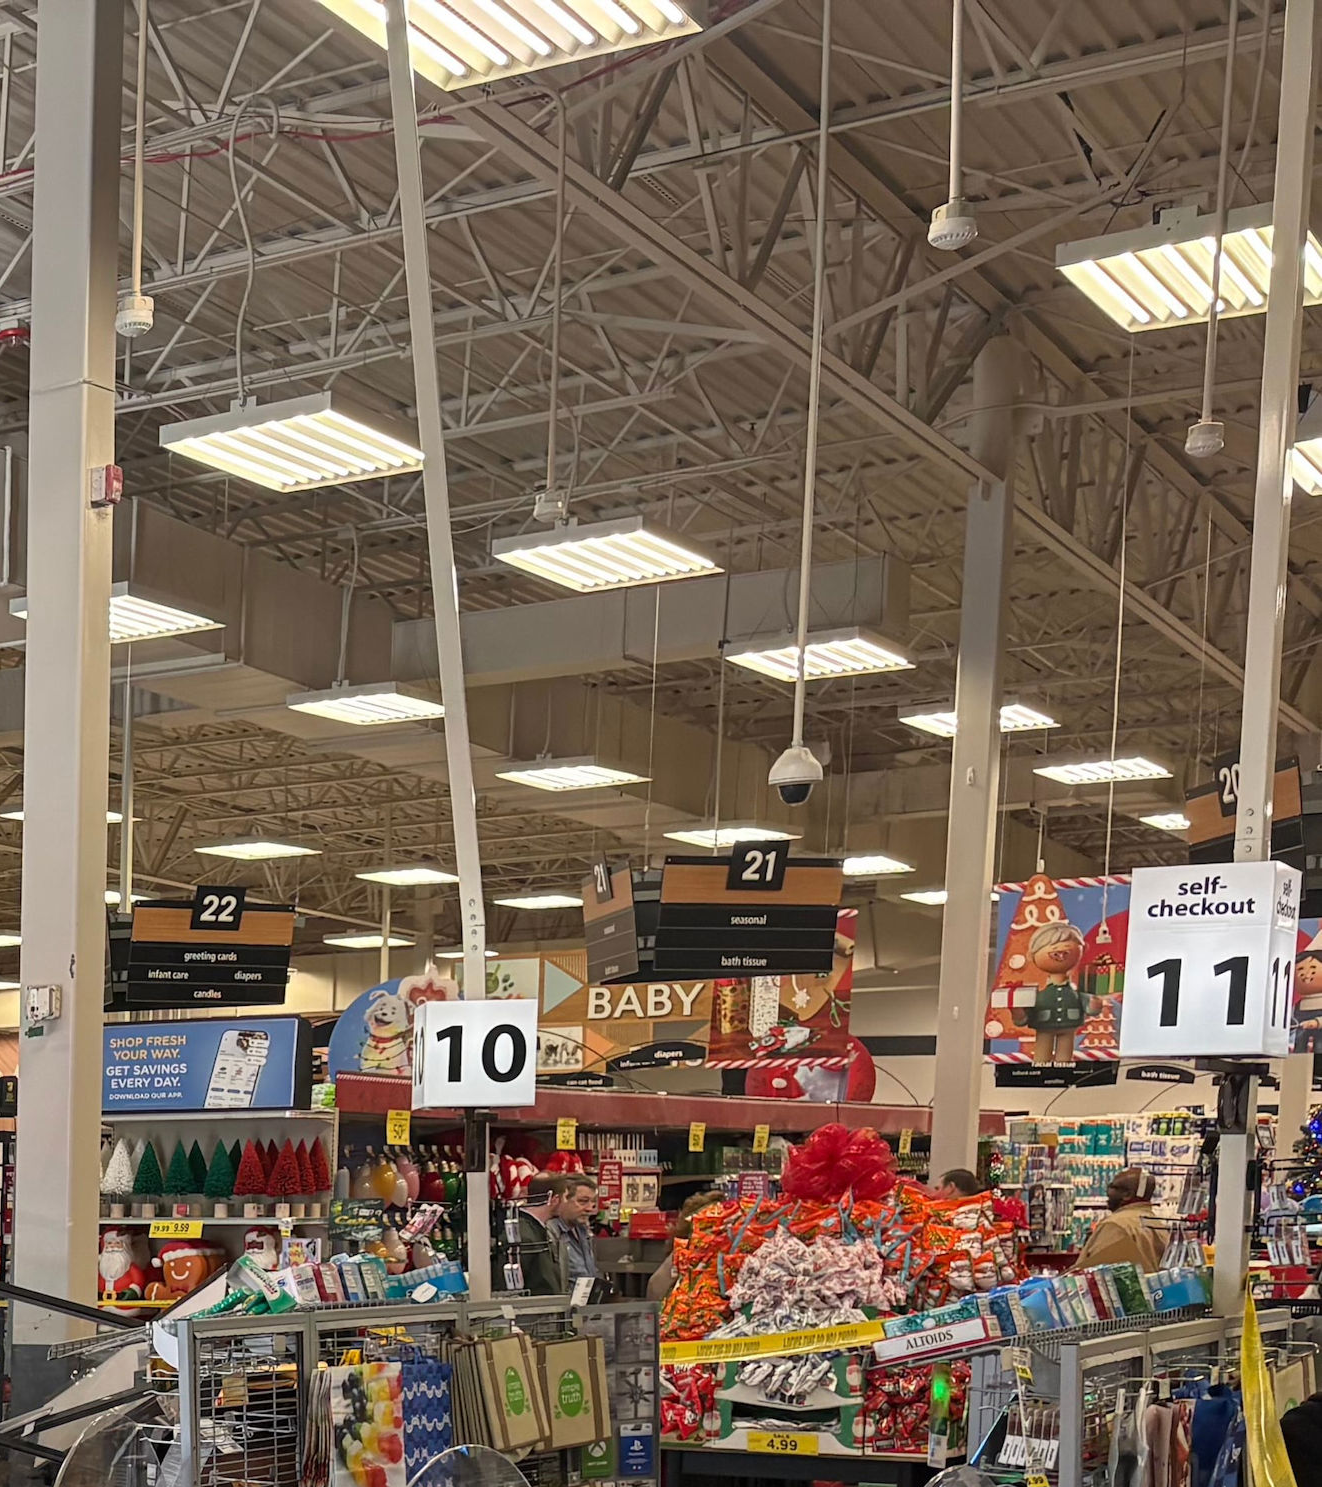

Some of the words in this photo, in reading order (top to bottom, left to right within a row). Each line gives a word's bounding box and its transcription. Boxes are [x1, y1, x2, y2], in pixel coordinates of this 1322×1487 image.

[742, 850, 777, 882] 21
[1178, 876, 1227, 896] self-
[200, 895, 237, 922] 22
[1147, 897, 1255, 918] checkout
[730, 914, 767, 926] seasonal
[184, 951, 215, 962] greeting
[217, 951, 238, 961] cards
[720, 955, 744, 967] bath
[746, 955, 768, 967] tissue
[148, 970, 171, 979] infant
[172, 971, 189, 980] care
[234, 971, 262, 982] diapers
[193, 988, 222, 999] candles
[1147, 956, 1249, 1027] 11
[587, 983, 705, 1019] BABY
[109, 1038, 143, 1048] SHOP
[146, 1035, 187, 1047] FRESH
[113, 1049, 149, 1061] YOUR
[151, 1048, 181, 1060] WAY.
[436, 1024, 527, 1083] 10
[106, 1065, 131, 1076] GET
[133, 1063, 187, 1076] SAVINGS
[110, 1077, 151, 1089] EVERY
[153, 1077, 181, 1088] DAY.
[108, 1092, 150, 1101] DOWNLOAD
[151, 1092, 166, 1100] OUR
[903, 1330, 954, 1350] ALTOIDS
[561, 1391, 581, 1404] truth
[766, 1439, 798, 1452] 4.99
